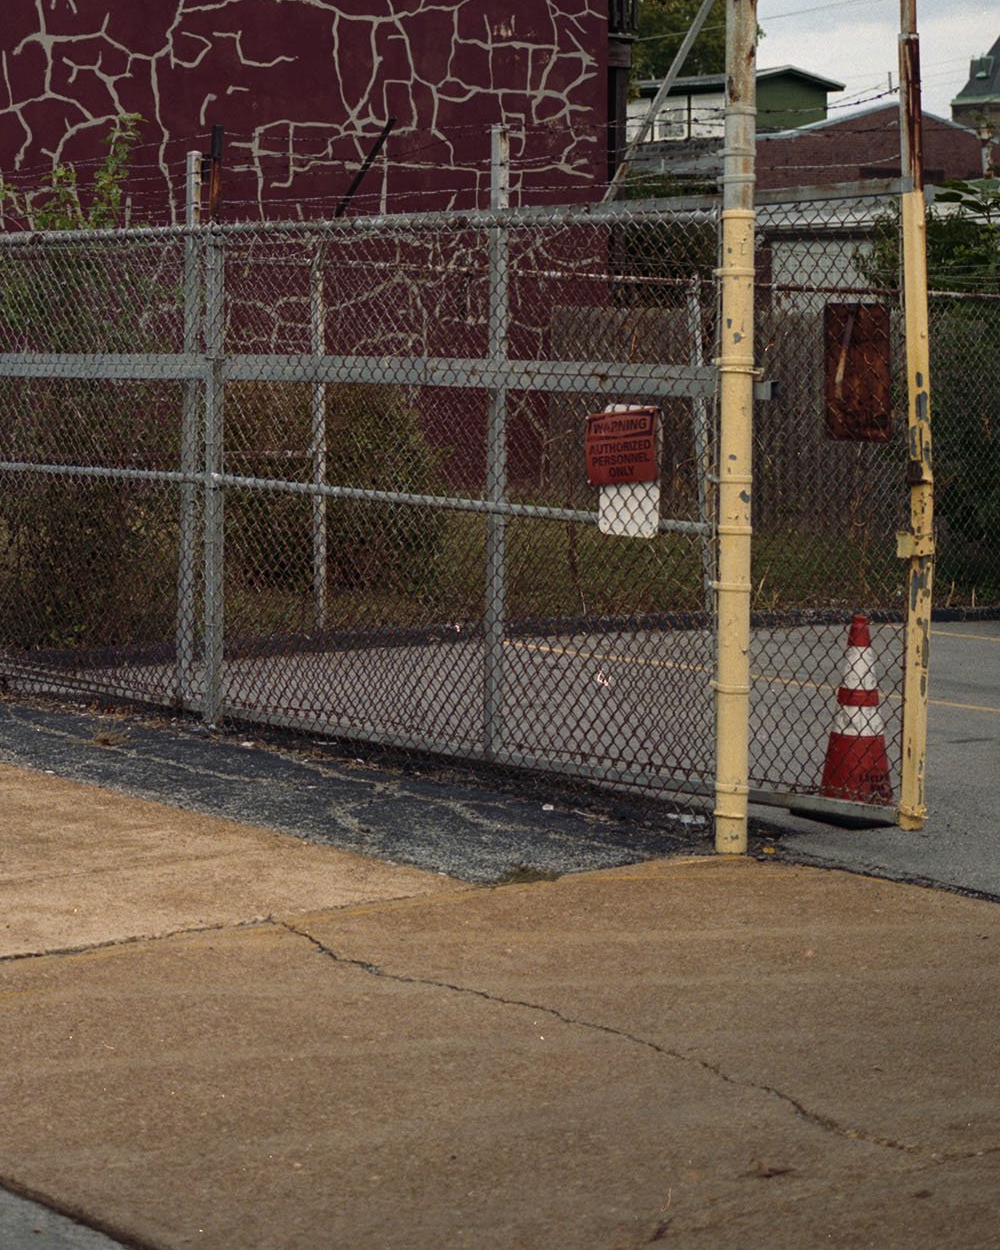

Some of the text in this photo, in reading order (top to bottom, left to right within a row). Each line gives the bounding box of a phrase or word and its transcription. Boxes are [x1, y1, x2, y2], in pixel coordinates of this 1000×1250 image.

[594, 418, 647, 434] WARNING
[590, 439, 651, 455] AUTHORIZED
[592, 452, 650, 467] PERSONNEL
[609, 466, 634, 477] ONLY
